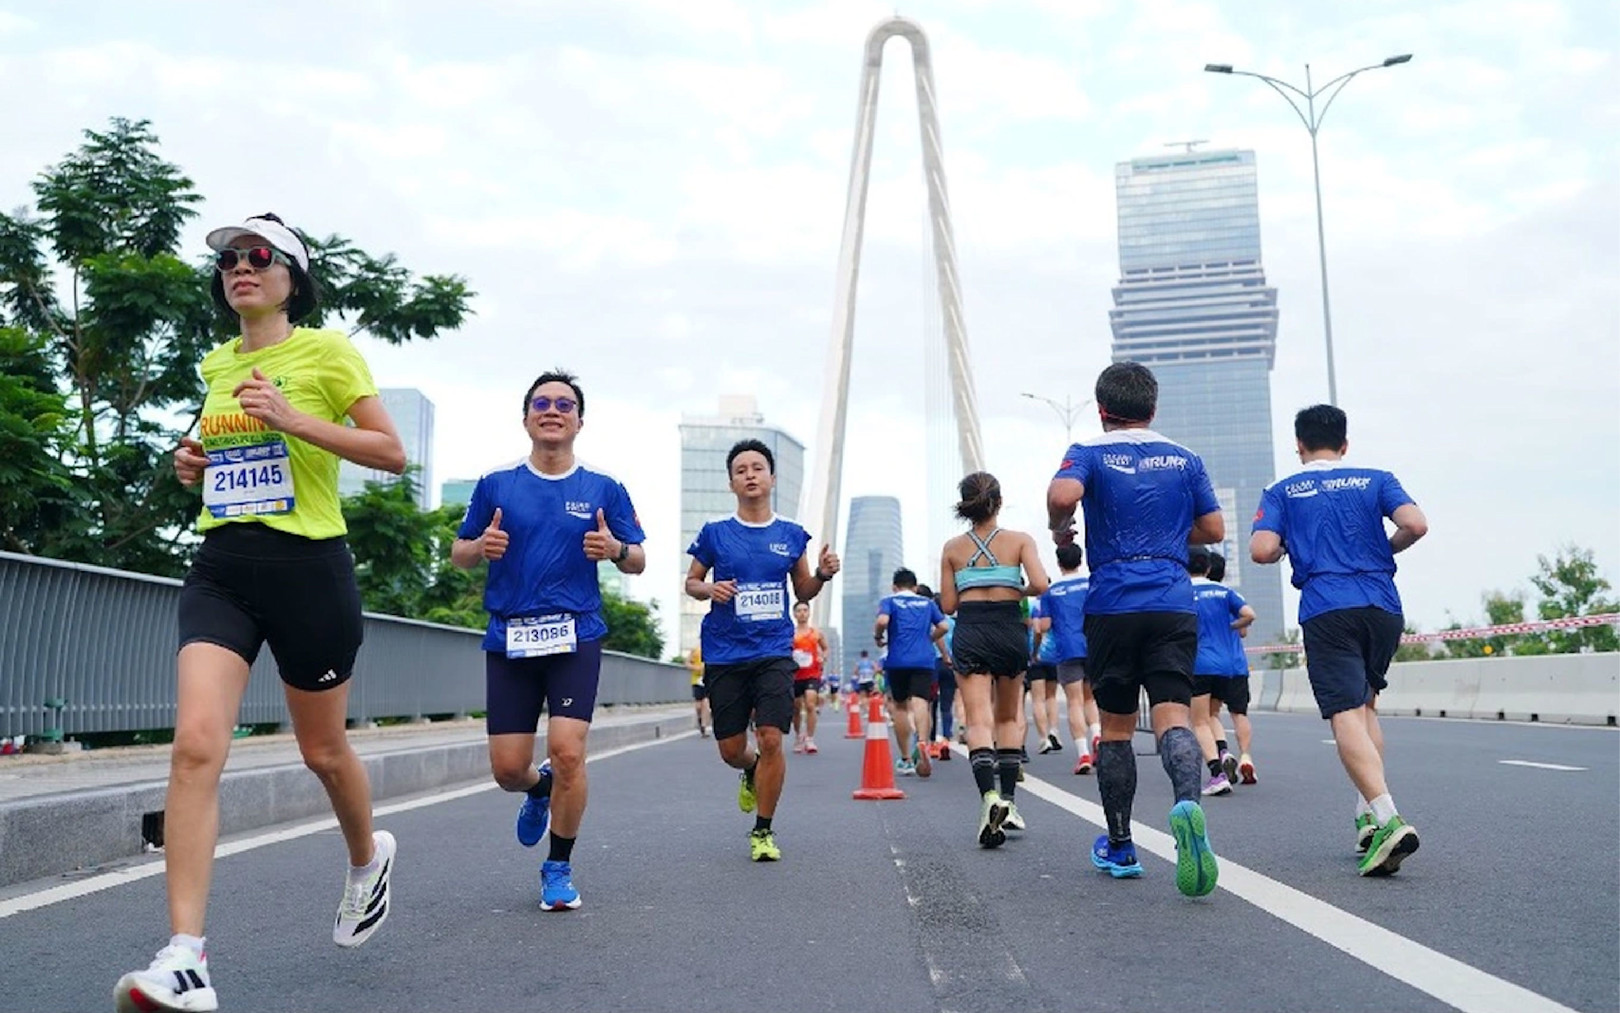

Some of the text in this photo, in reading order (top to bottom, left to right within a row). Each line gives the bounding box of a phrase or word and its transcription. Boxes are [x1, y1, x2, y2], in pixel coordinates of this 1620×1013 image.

[201, 412, 268, 436] RUNNIN
[214, 464, 283, 492] 214145
[513, 625, 569, 643] 213086
